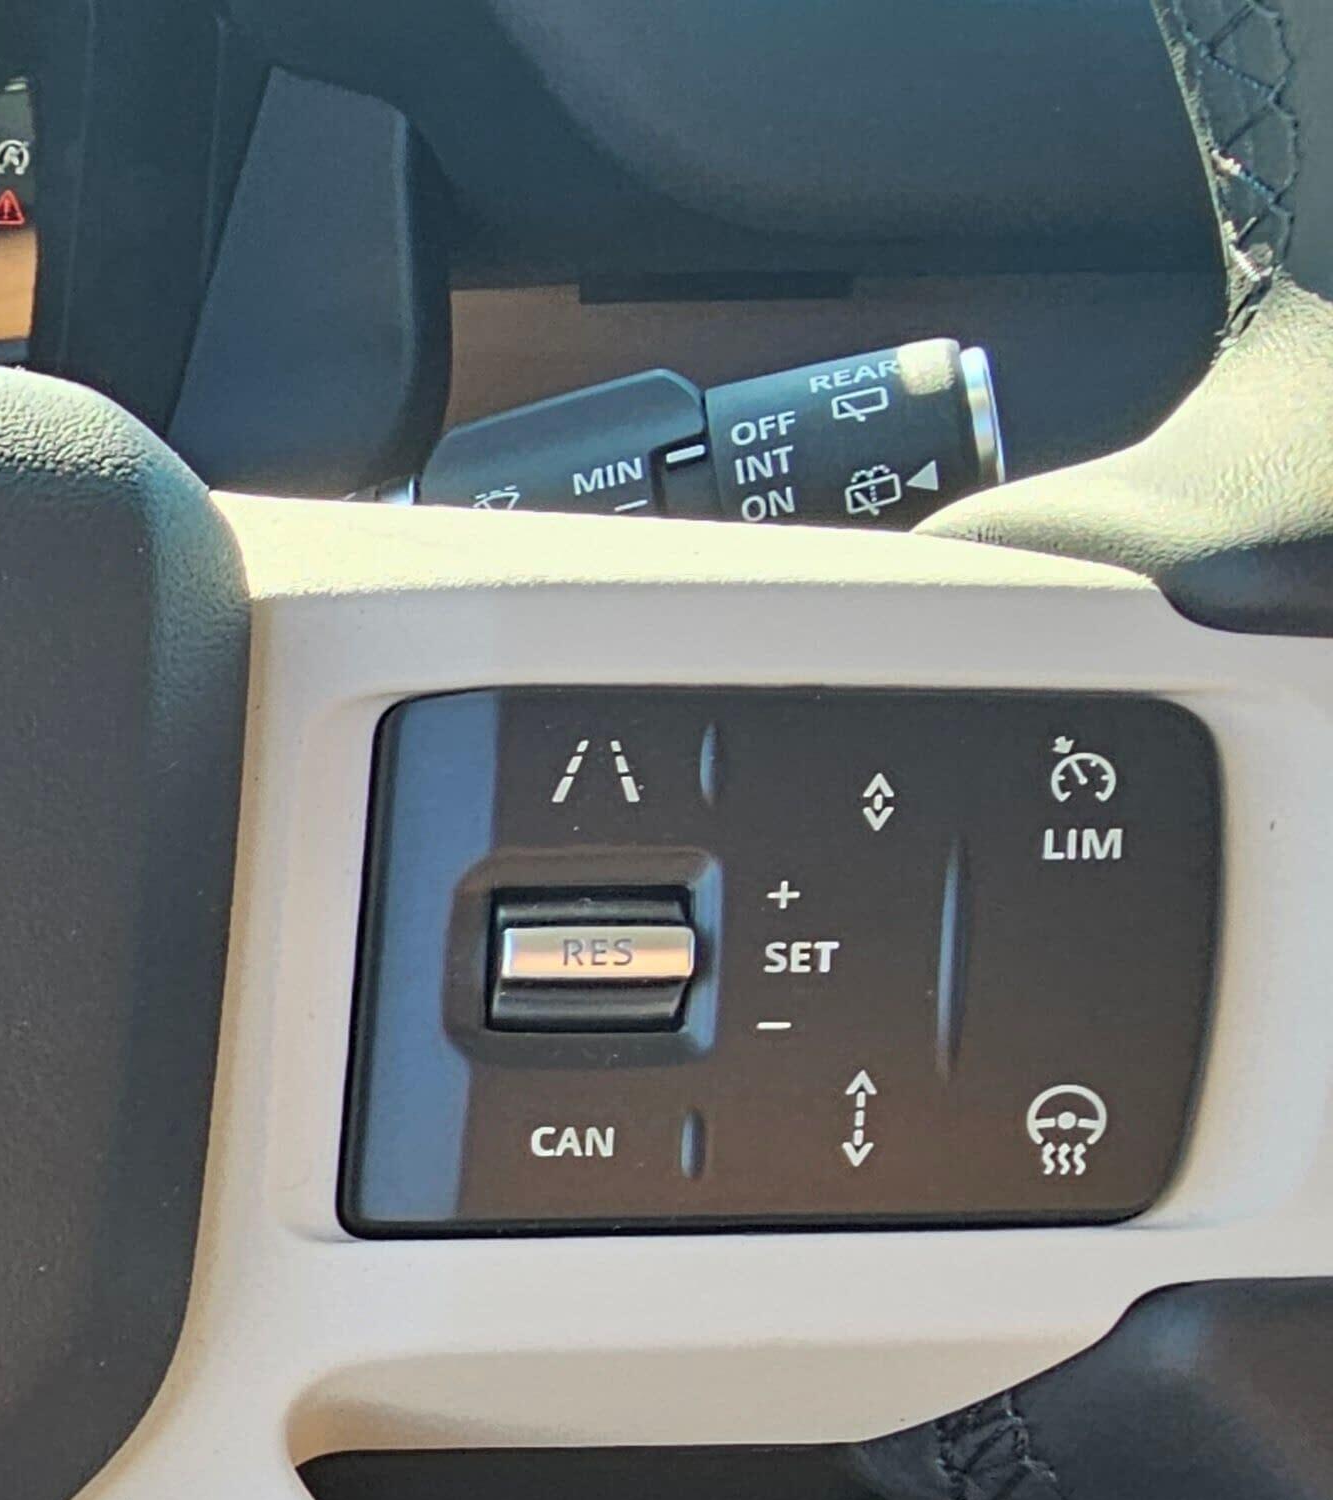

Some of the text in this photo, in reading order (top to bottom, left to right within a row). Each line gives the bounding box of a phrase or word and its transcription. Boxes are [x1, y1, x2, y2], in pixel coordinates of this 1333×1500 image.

[808, 359, 901, 394] REAR
[730, 410, 797, 447] OFF
[571, 456, 643, 497] MIN
[734, 446, 795, 485] INT
[739, 485, 796, 523] ON
[1041, 828, 1124, 861] LIM
[562, 936, 635, 967] RES
[762, 940, 840, 975] SET
[530, 1125, 615, 1159] CAN
